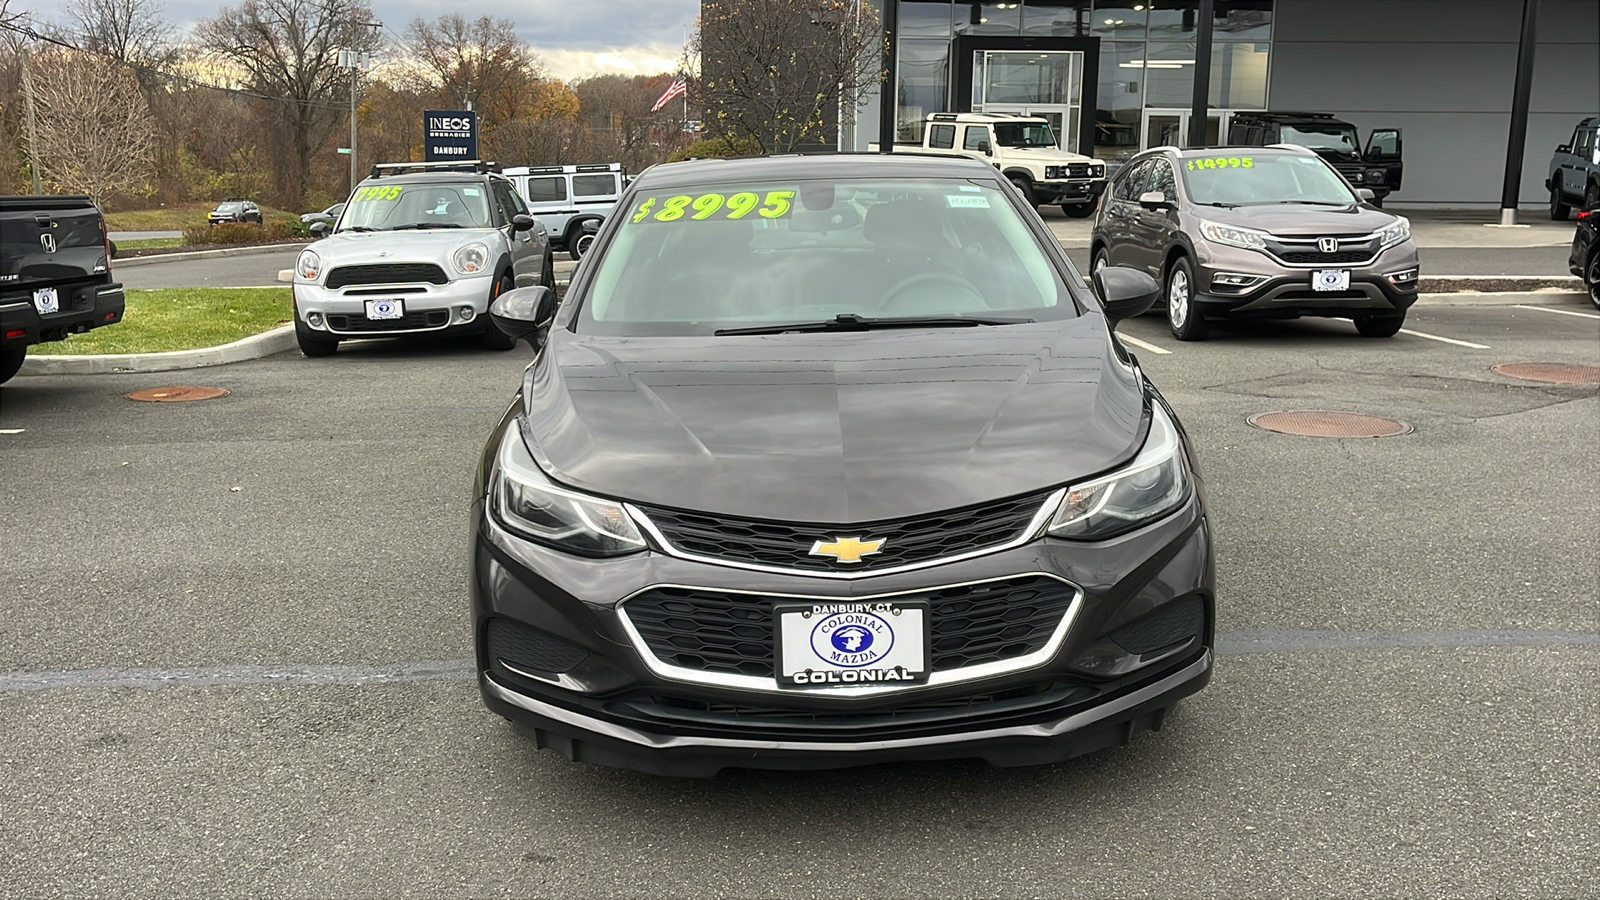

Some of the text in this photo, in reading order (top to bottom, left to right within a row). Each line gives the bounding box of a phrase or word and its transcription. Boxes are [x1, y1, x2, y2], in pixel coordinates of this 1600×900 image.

[429, 117, 471, 130] INEOS
[433, 146, 468, 155] DANBURY
[1187, 156, 1254, 172] $14995
[632, 190, 796, 224] $8995
[875, 602, 893, 613] CT
[821, 614, 884, 634] COLONIAL
[829, 649, 878, 664] MAZDA
[793, 668, 915, 684] COLONIAL
